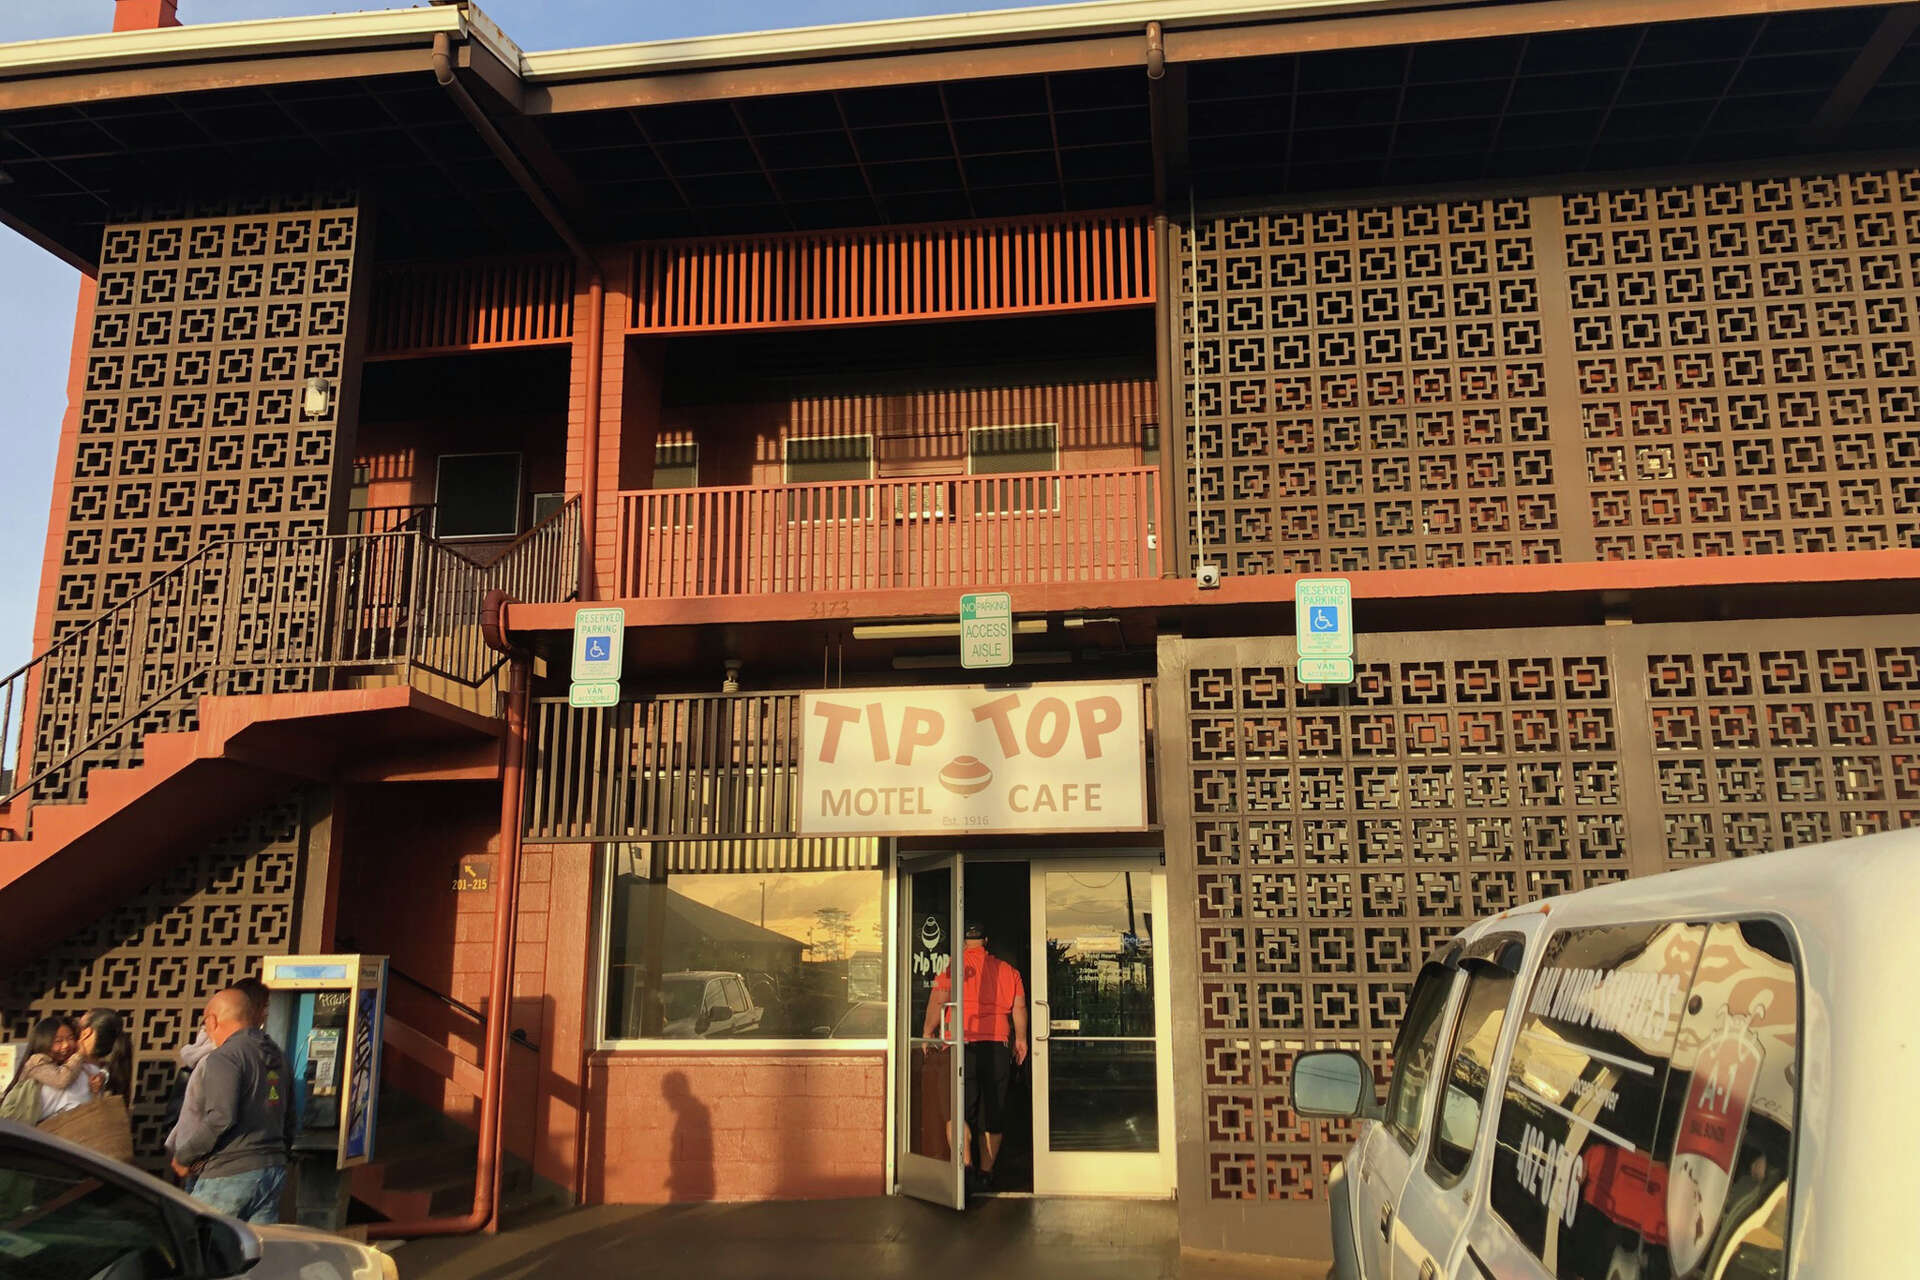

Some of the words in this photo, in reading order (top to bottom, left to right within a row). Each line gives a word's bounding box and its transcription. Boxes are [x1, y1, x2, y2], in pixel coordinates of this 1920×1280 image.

[1299, 585, 1346, 595] RESERVED
[962, 601, 976, 613] NO
[976, 599, 1008, 611] PARKING
[1303, 596, 1344, 606] PARKING
[808, 601, 850, 618] 3173
[579, 613, 621, 624] RESERVED
[581, 624, 618, 634] PARKING
[965, 623, 1008, 638] ACCESS
[971, 643, 1001, 657] AISLE
[586, 687, 603, 695] VAN
[813, 700, 946, 767] TIP
[971, 692, 1123, 761] TOP
[820, 786, 932, 817] MOTEL
[1007, 783, 1102, 813] CAFE
[964, 815, 989, 826] 1916
[451, 879, 488, 890] 201-215
